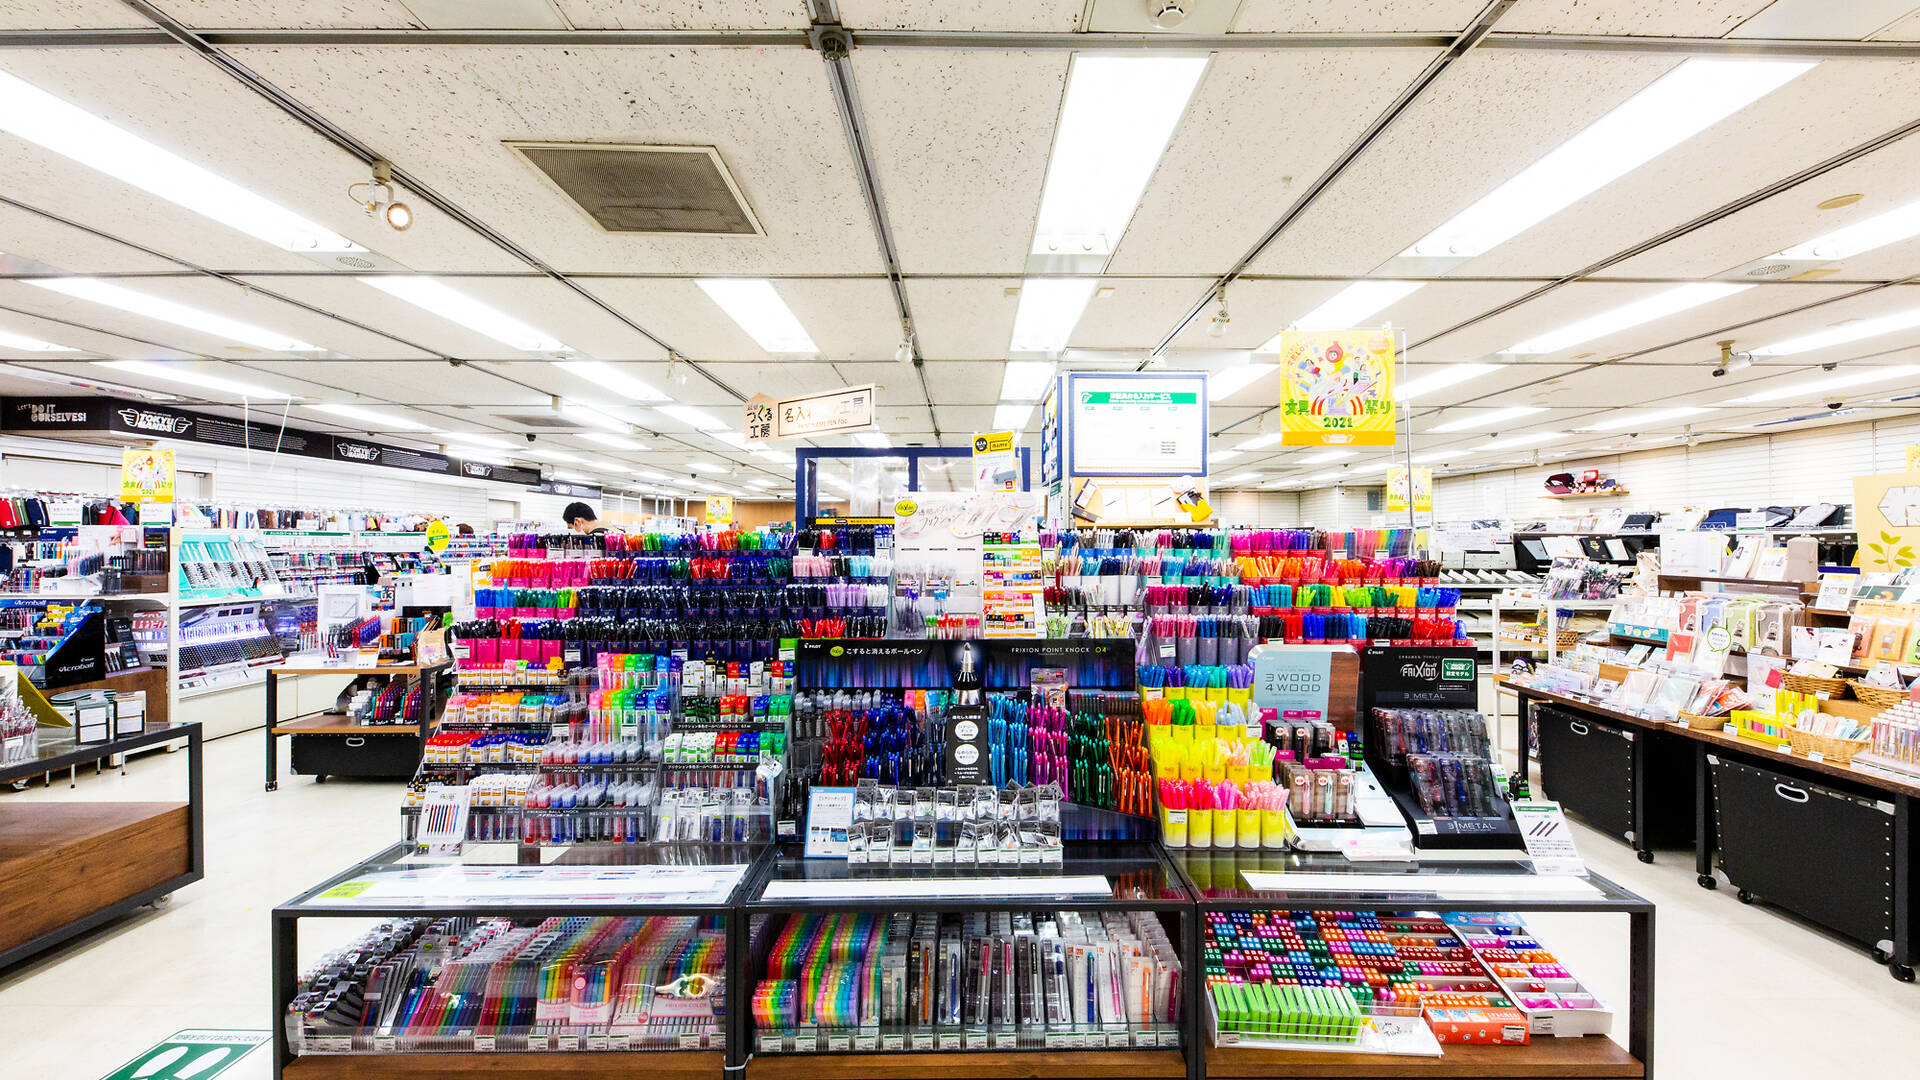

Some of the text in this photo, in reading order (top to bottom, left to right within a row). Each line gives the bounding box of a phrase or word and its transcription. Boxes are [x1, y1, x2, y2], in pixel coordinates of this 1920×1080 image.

[46, 404, 56, 413] IT
[1285, 398, 1391, 415] 文具 祭り
[31, 412, 87, 422] OURSELVES!
[139, 413, 174, 426] TOKYU
[747, 407, 773, 423] つくる
[138, 422, 173, 433] HANDS
[1323, 417, 1353, 428] 2021
[750, 423, 771, 438] 工房
[846, 647, 923, 655] こすると消えるボールペン
[59, 662, 95, 673] Acroball
[1265, 673, 1322, 682] 3 WOOD
[1265, 683, 1321, 692] 4 WOOD
[1448, 822, 1497, 830] 3 METAL
